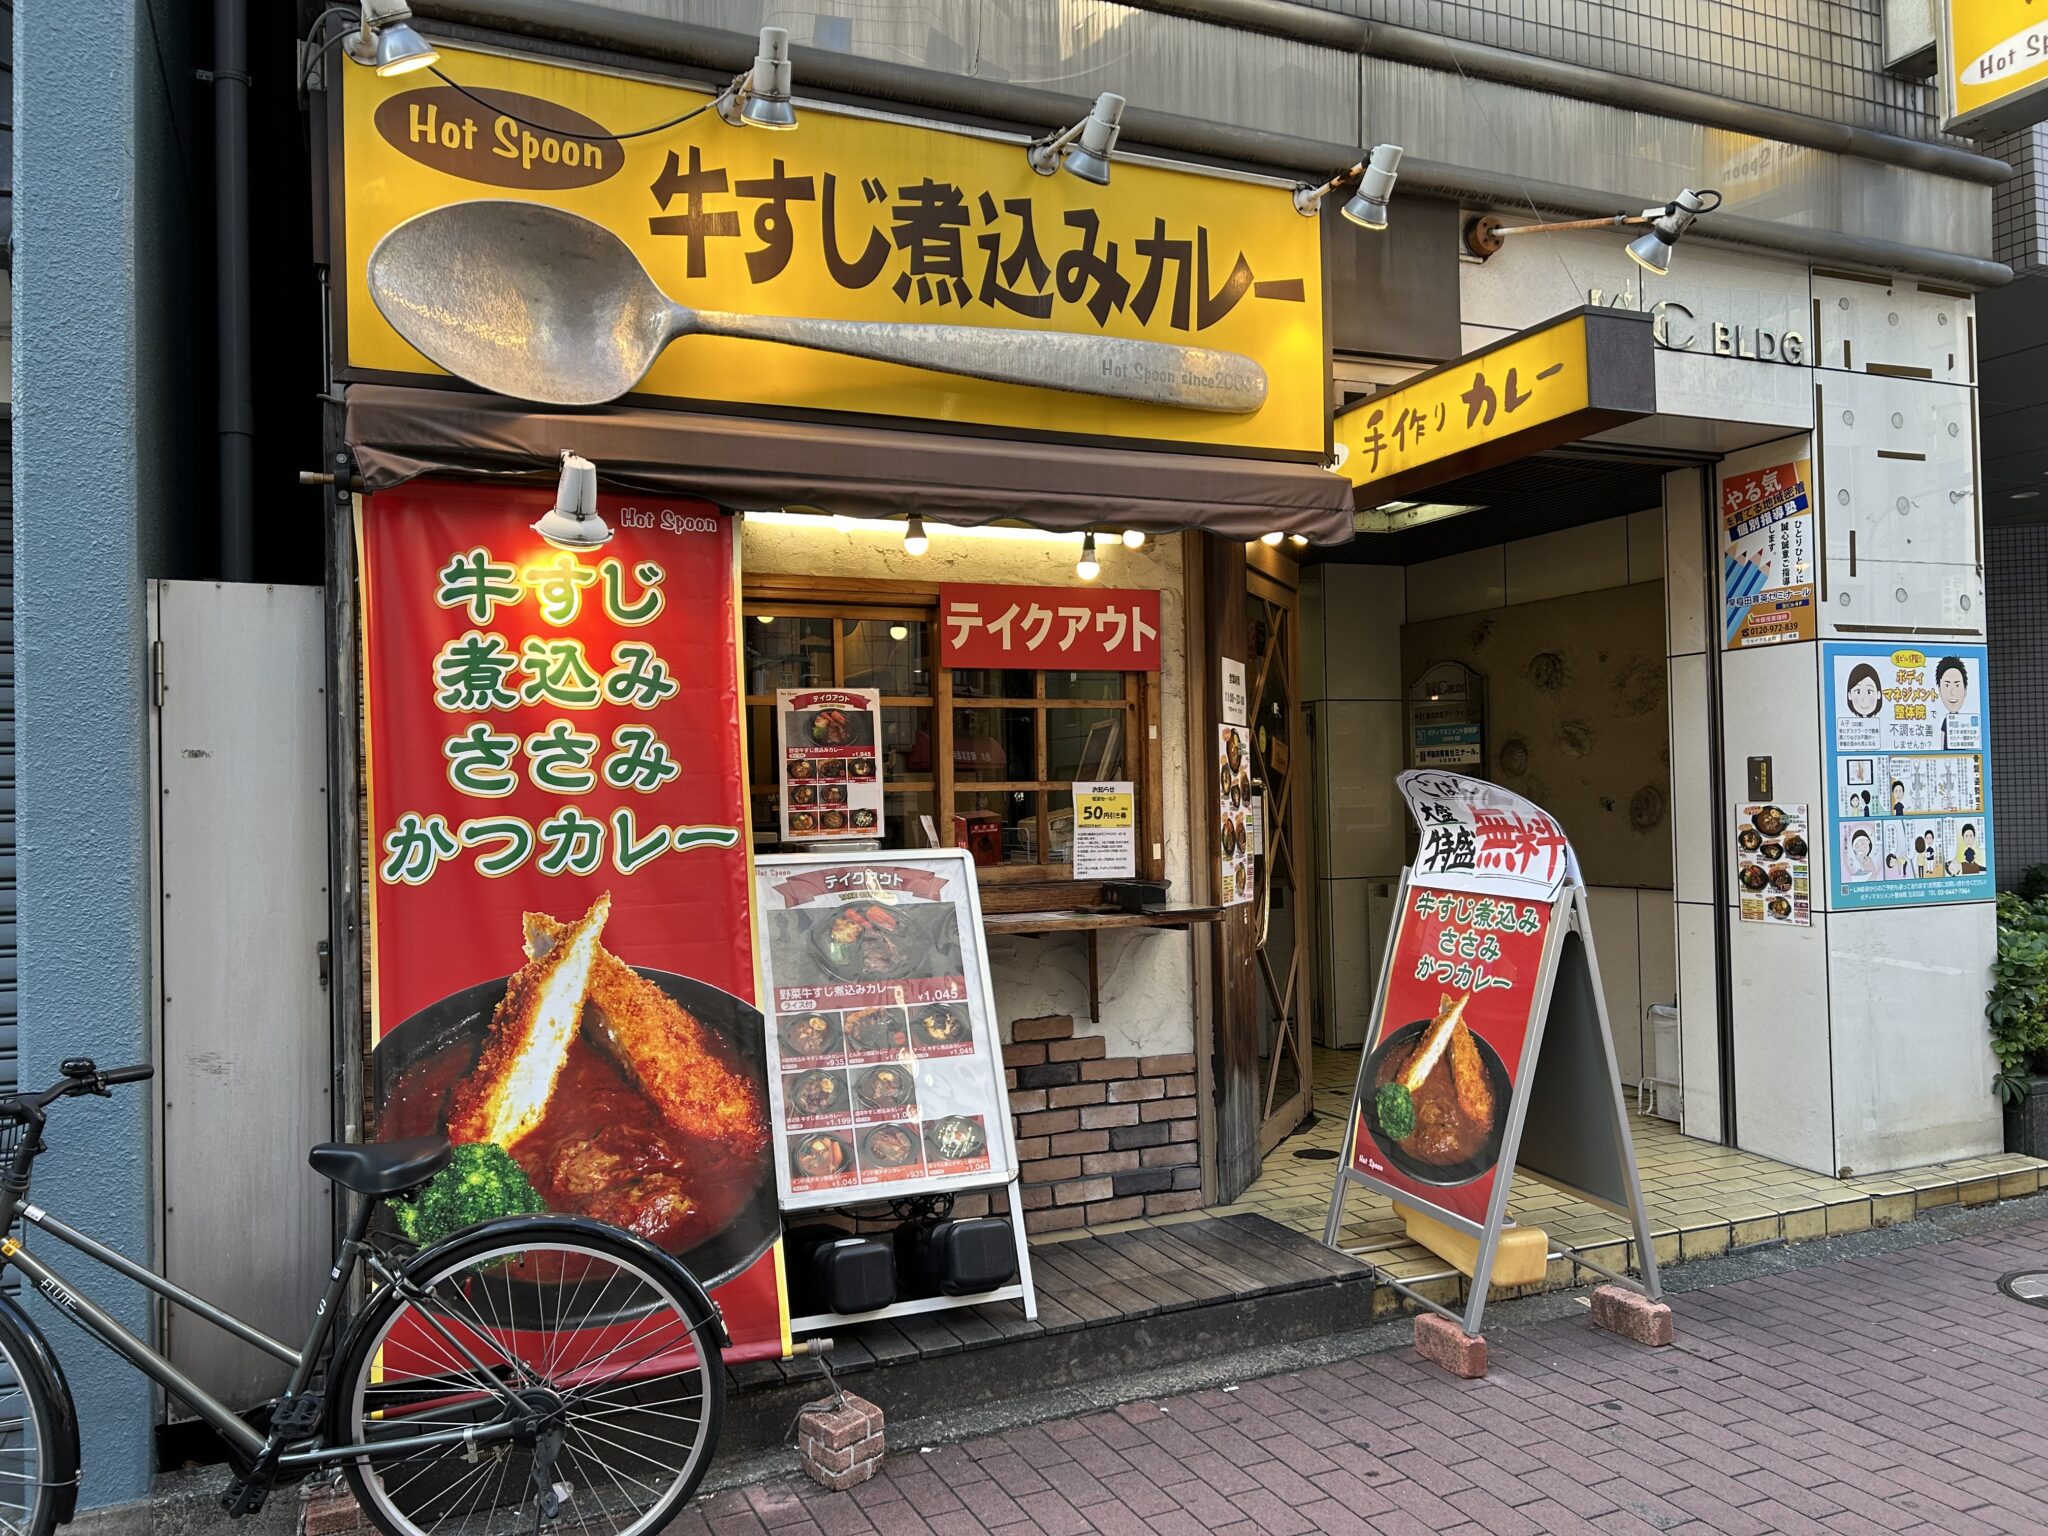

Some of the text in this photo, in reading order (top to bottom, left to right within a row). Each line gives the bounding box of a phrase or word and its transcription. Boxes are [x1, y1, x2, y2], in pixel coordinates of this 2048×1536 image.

[1980, 49, 2016, 78] Hot
[408, 103, 603, 174] Hot Spoon
[649, 146, 1305, 332] 牛すじ煮込みカレー
[1712, 321, 1805, 366] BLDG
[1102, 359, 1128, 377] Hot
[1134, 362, 1175, 384] Spoon
[1726, 470, 1782, 510] やる気
[621, 508, 717, 534] Hot Spoon
[434, 545, 667, 627] 牛すじ
[946, 602, 1157, 652] テイクアウト
[1750, 623, 1799, 635] 0120-972-839
[433, 630, 680, 713] 煮込み
[1896, 669, 1924, 685] ボディ
[812, 694, 850, 703] テイクアウト
[1883, 687, 1938, 702] マネジメント
[442, 719, 681, 798] ささみ
[380, 806, 740, 886] かつカレー
[1424, 826, 1475, 872] 特盛
[1467, 804, 1566, 881] 無料
[1415, 891, 1541, 937] 牛すじ煮込み
[1438, 927, 1501, 962] ささみ
[779, 983, 896, 1000] 野菜牛すじ煮込みカレー
[1414, 954, 1513, 991] かつカレー
